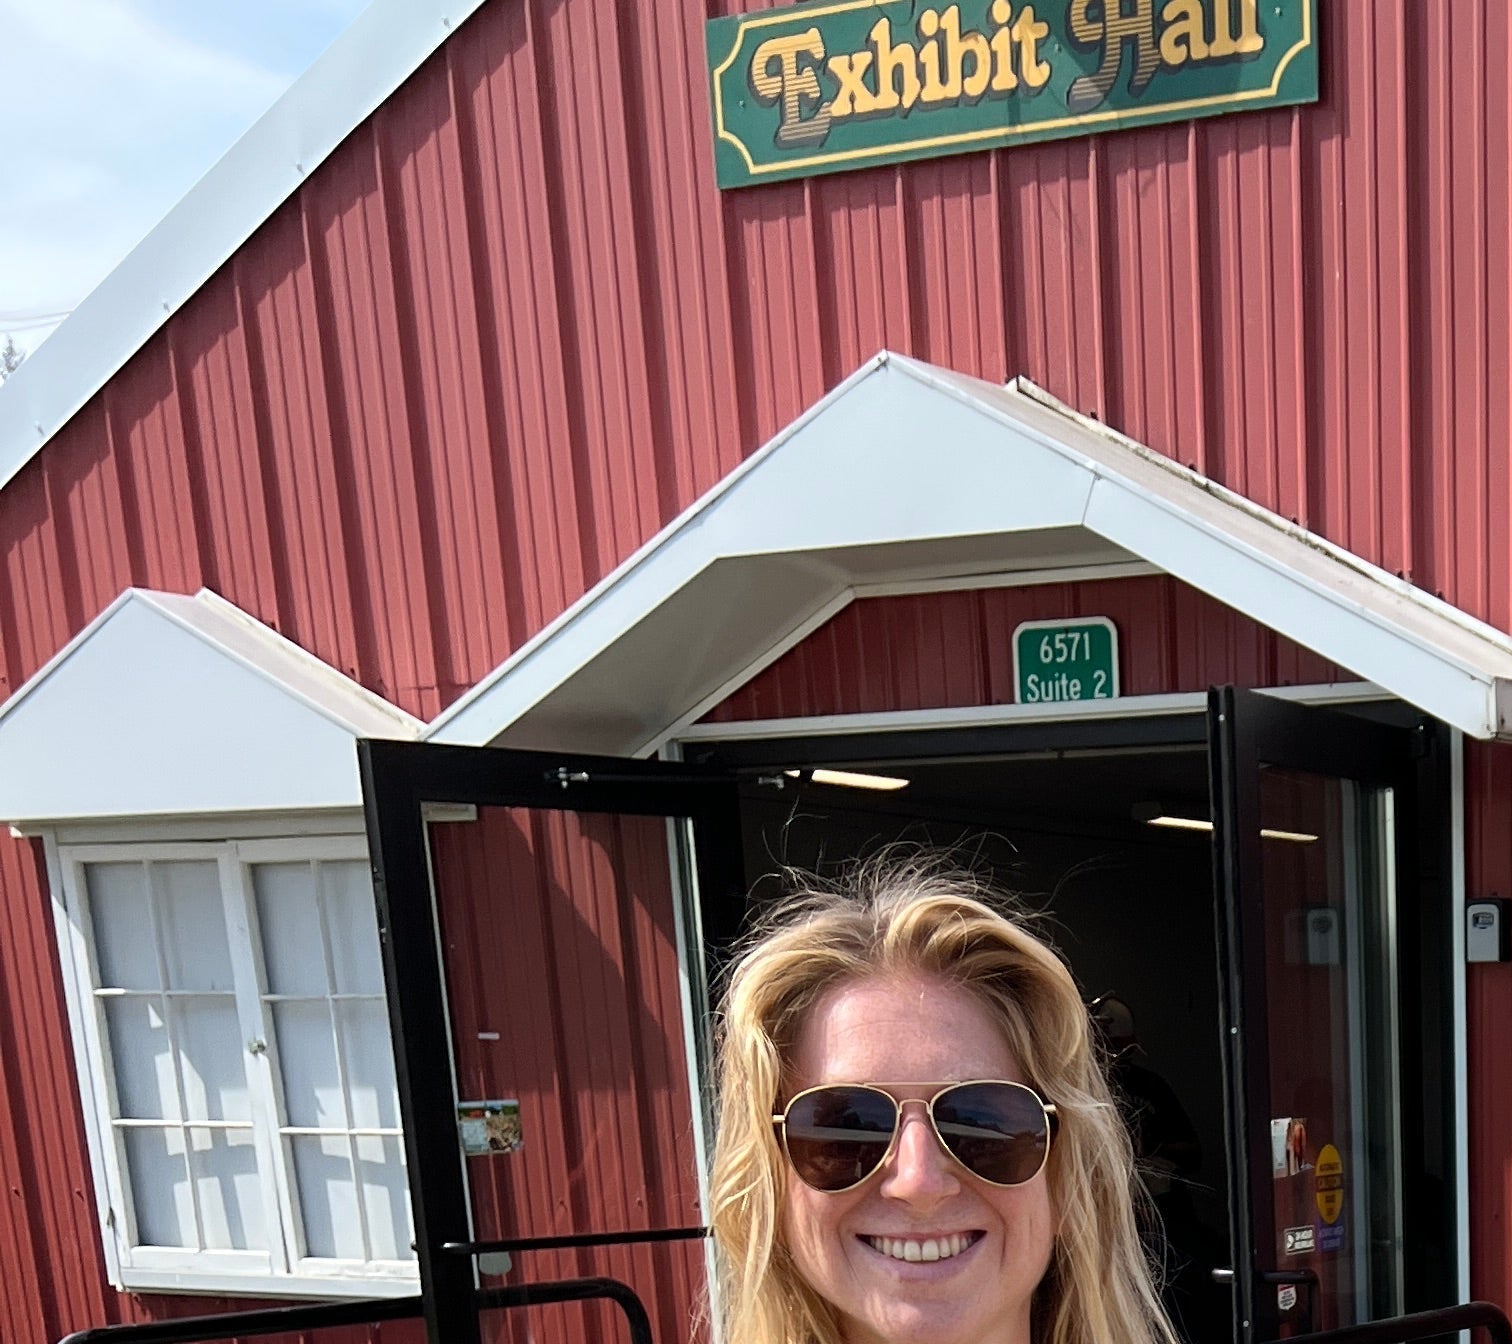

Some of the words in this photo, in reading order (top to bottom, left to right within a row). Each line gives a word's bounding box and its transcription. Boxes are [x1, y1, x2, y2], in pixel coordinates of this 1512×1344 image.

[751, 0, 1051, 142] Exhibit
[1069, 0, 1265, 101] Hall
[1039, 631, 1090, 664] 6571
[1026, 672, 1082, 703] Suite
[1092, 669, 1107, 700] 2
